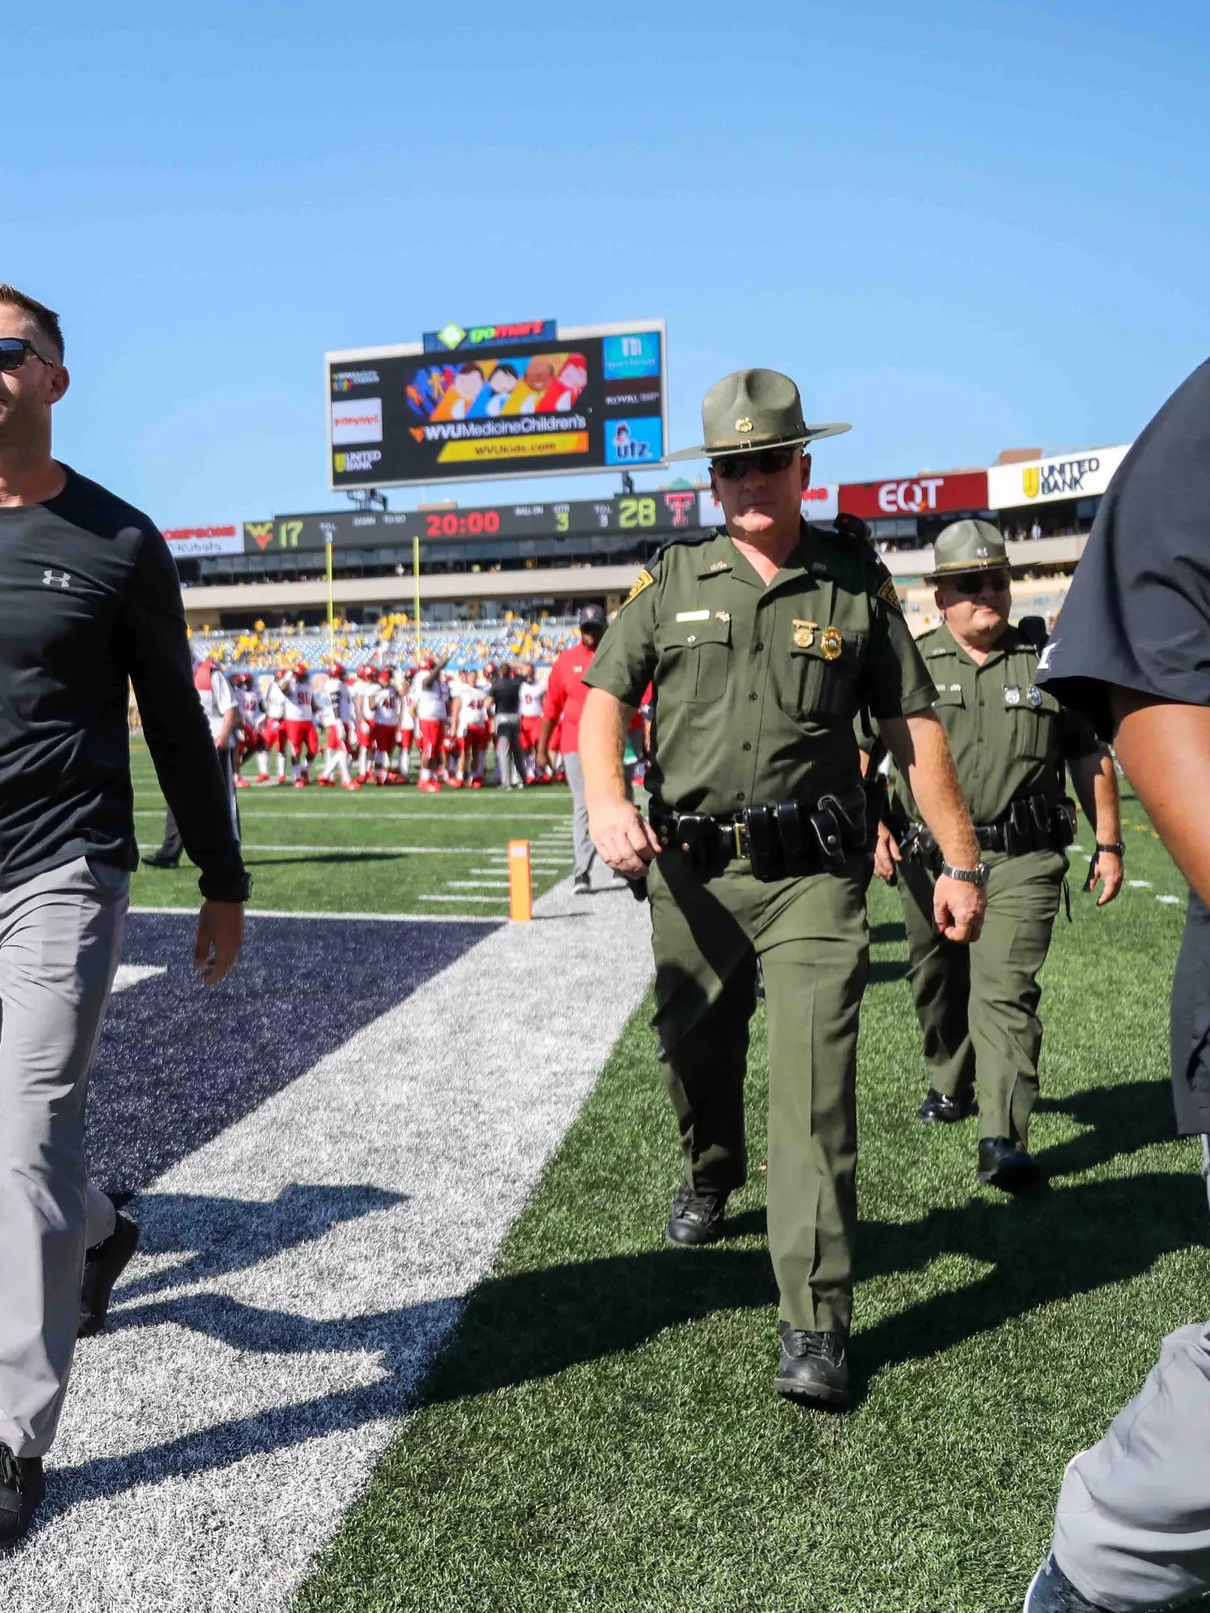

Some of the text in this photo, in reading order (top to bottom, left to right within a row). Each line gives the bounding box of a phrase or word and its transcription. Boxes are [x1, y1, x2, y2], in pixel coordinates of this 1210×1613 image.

[1041, 457, 1100, 481] UNITED
[878, 478, 944, 513] EQT
[1041, 476, 1084, 495] BANK
[426, 510, 501, 537] 20:00
[618, 498, 656, 528] 28
[279, 520, 304, 548] 17
